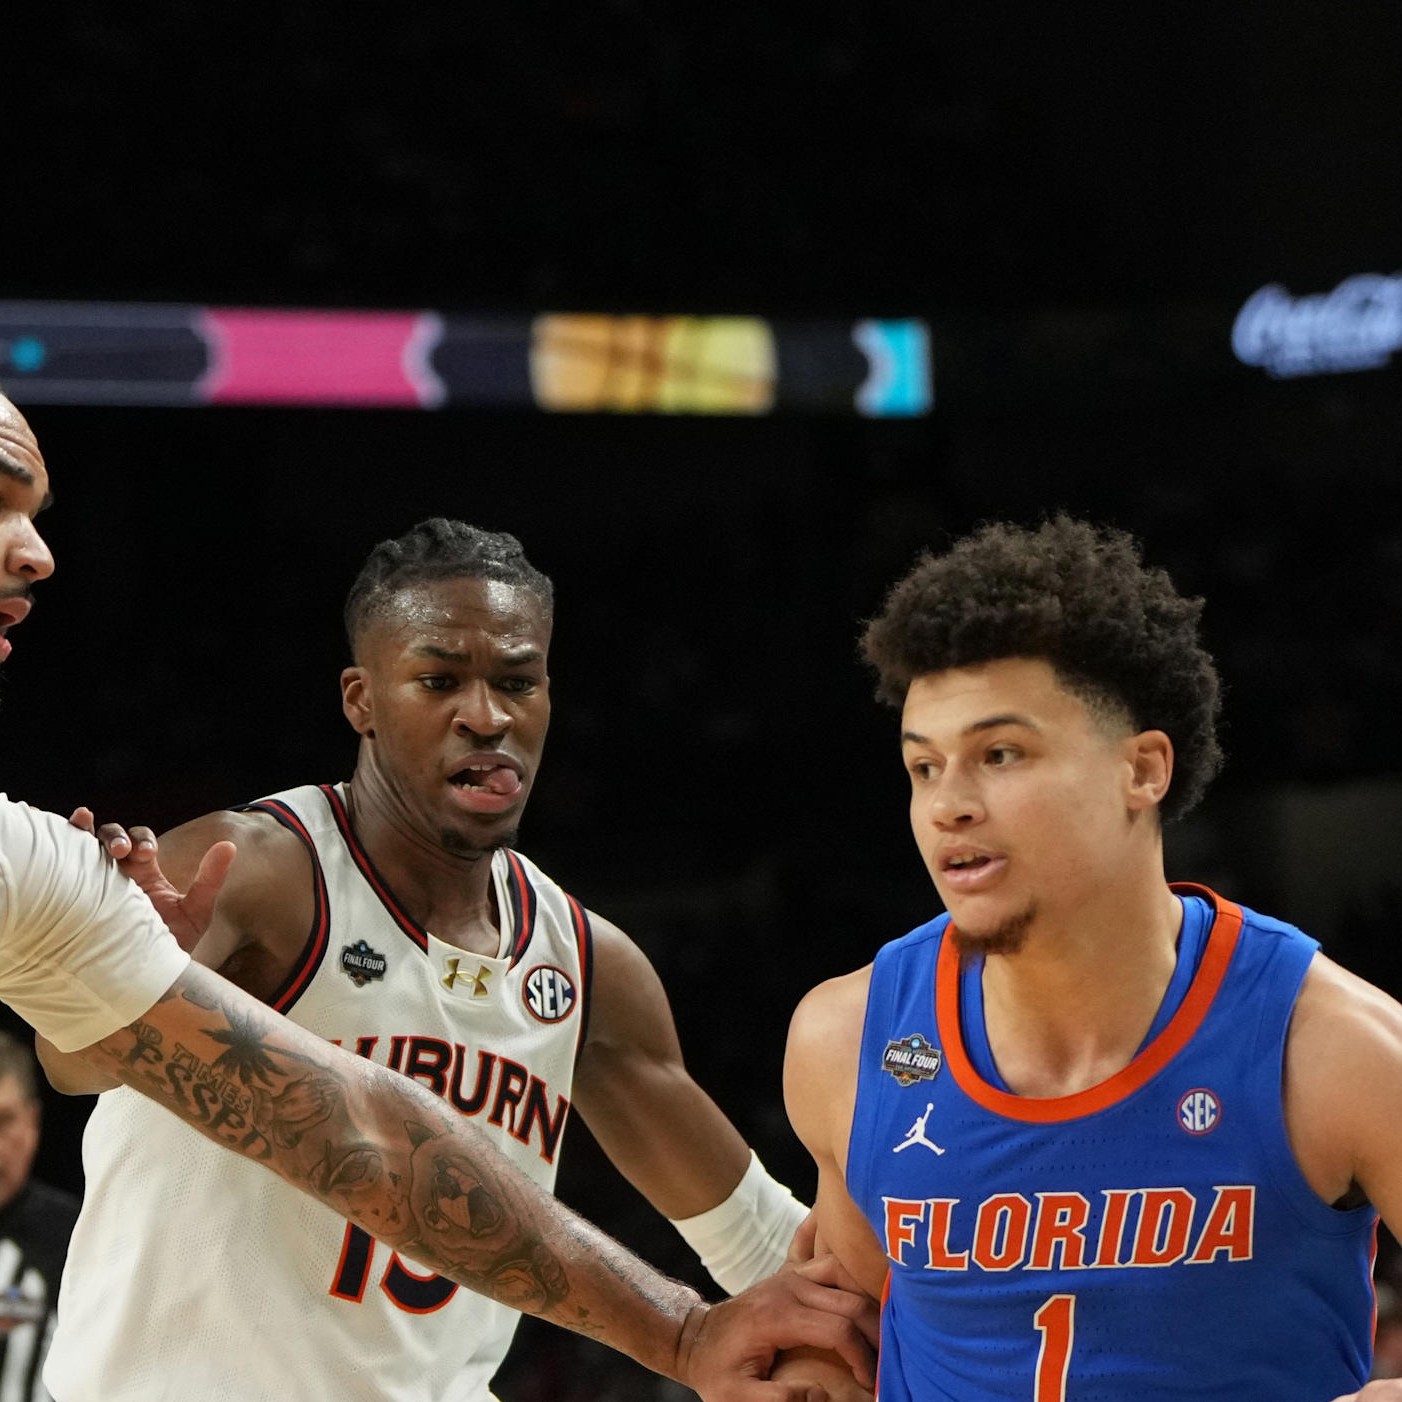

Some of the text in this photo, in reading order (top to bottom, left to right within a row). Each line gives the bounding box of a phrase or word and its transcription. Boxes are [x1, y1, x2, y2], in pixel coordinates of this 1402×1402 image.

[343, 952, 385, 971] FINAL FOUR
[526, 966, 575, 1020] SEC
[885, 1049, 939, 1070] FINAL FOUR
[334, 1035, 570, 1165] BURN
[1181, 1091, 1217, 1132] SEC
[882, 1185, 1257, 1273] FLORIDA
